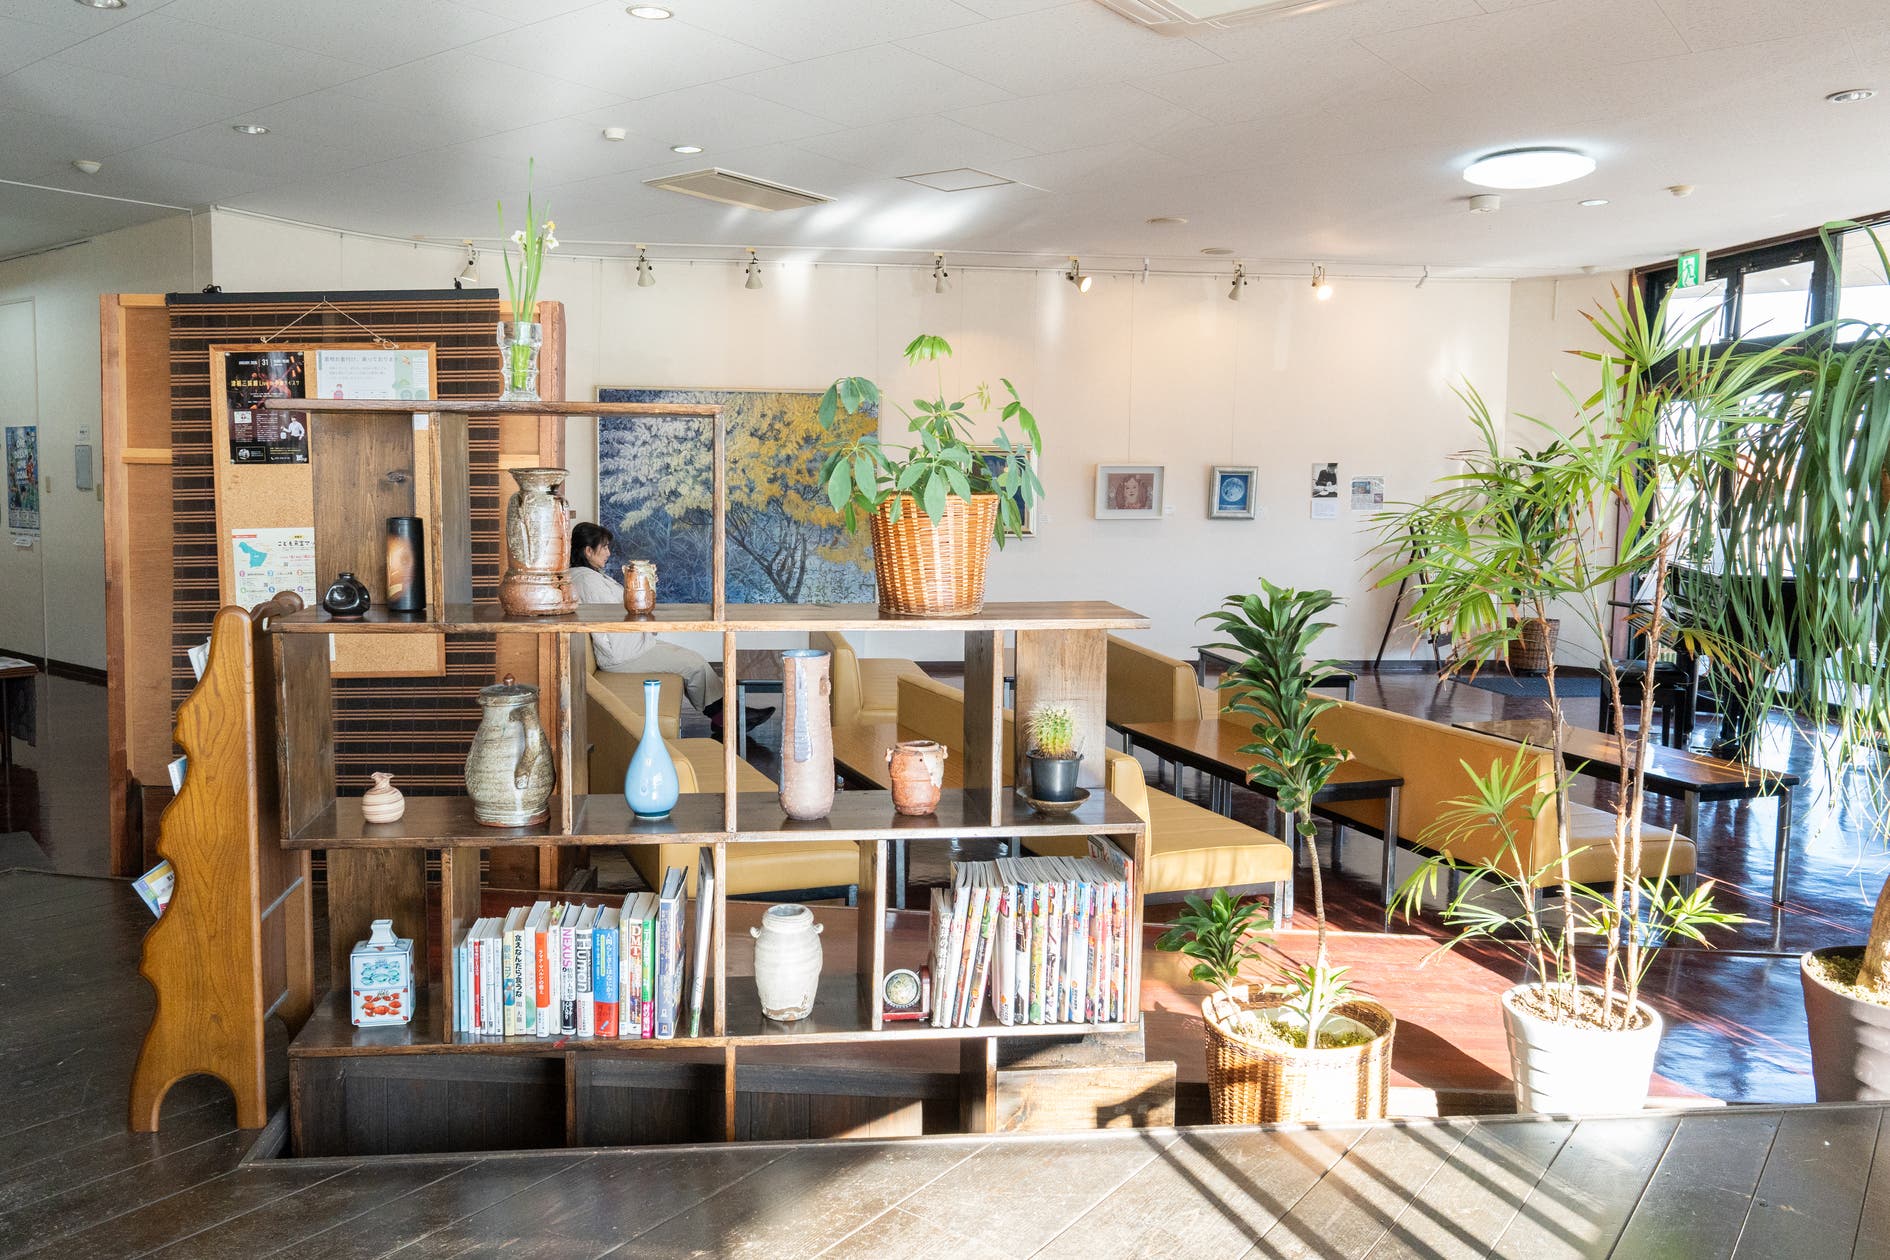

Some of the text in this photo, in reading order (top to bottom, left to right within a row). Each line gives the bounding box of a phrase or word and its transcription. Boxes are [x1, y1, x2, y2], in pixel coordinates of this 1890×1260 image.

[261, 358, 269, 366] 31
[562, 928, 572, 968] NEXUS
[630, 926, 641, 956] DMT
[514, 934, 523, 998] 食えなんだら食うな
